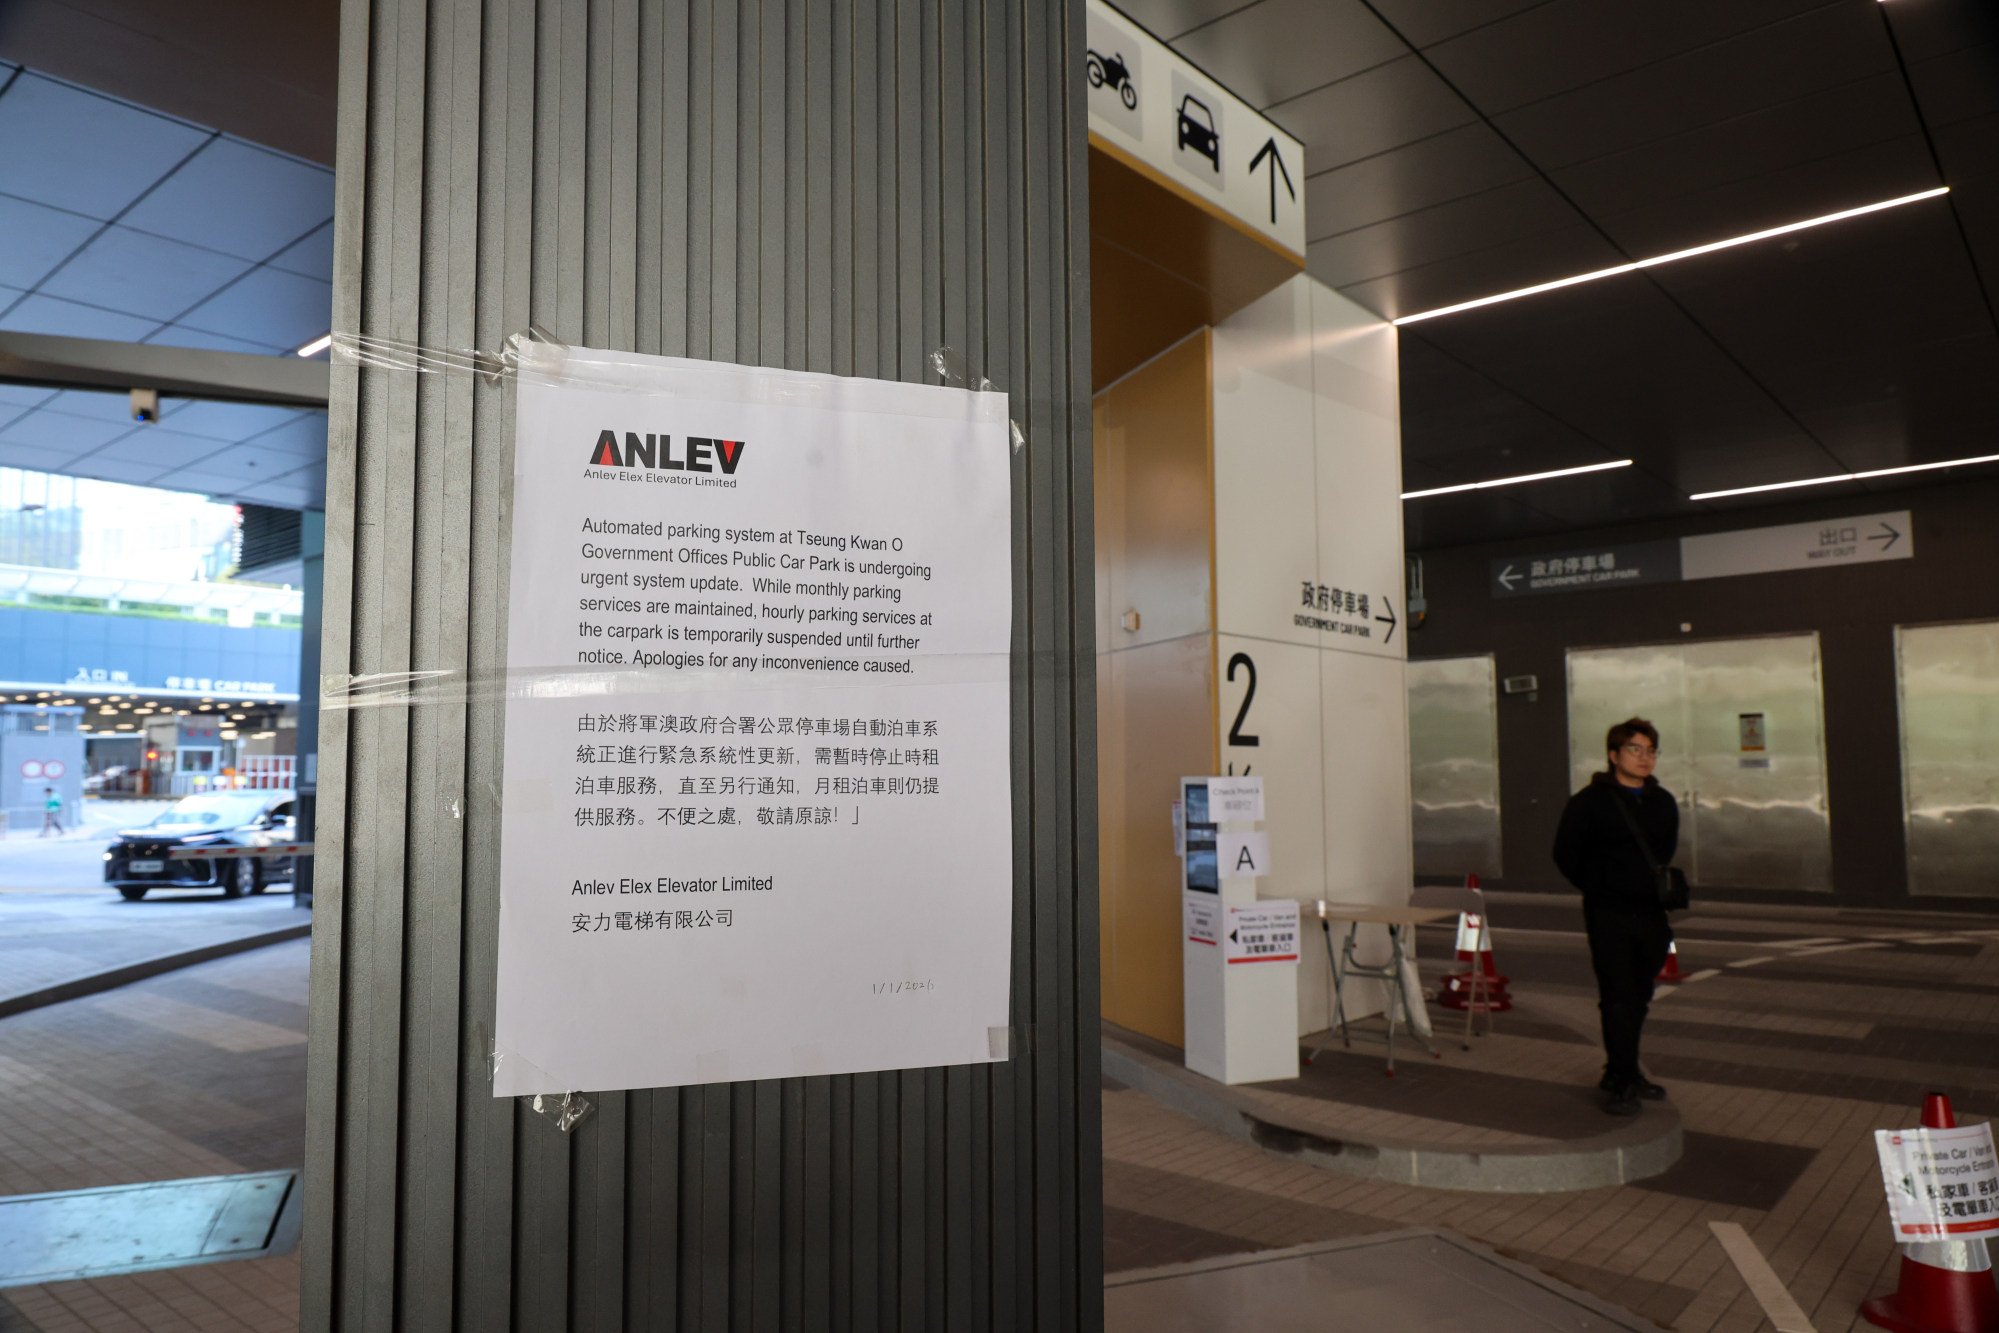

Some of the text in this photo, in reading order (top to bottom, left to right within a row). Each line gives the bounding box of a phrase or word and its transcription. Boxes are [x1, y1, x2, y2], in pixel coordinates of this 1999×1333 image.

[589, 429, 746, 475] ANLEV
[583, 468, 737, 489] Anlev Elex Elevator Limited
[581, 517, 904, 552] Automated parking system at Tseung Kwan O
[581, 542, 932, 582] Government Offices Public Car Park is undergoing
[580, 571, 902, 604] urgent system update. While monthly parking
[1302, 581, 1369, 620] 政府停車場
[579, 595, 933, 626] services are maintained, hourly parking services at
[1294, 613, 1340, 632] GOVERNMENT
[578, 620, 921, 650] the carpark is temporarily suspended until further
[578, 648, 914, 674] notice. Apologies for any inconvenience caused.
[1227, 652, 1260, 747] 2
[577, 713, 939, 738] 由於將軍澳政府合署公眾停車場自動泊車系
[1236, 845, 1255, 871] A
[571, 875, 773, 896] Anlev Elex Elevator Limited
[571, 909, 733, 933] 安力電梯有限公司
